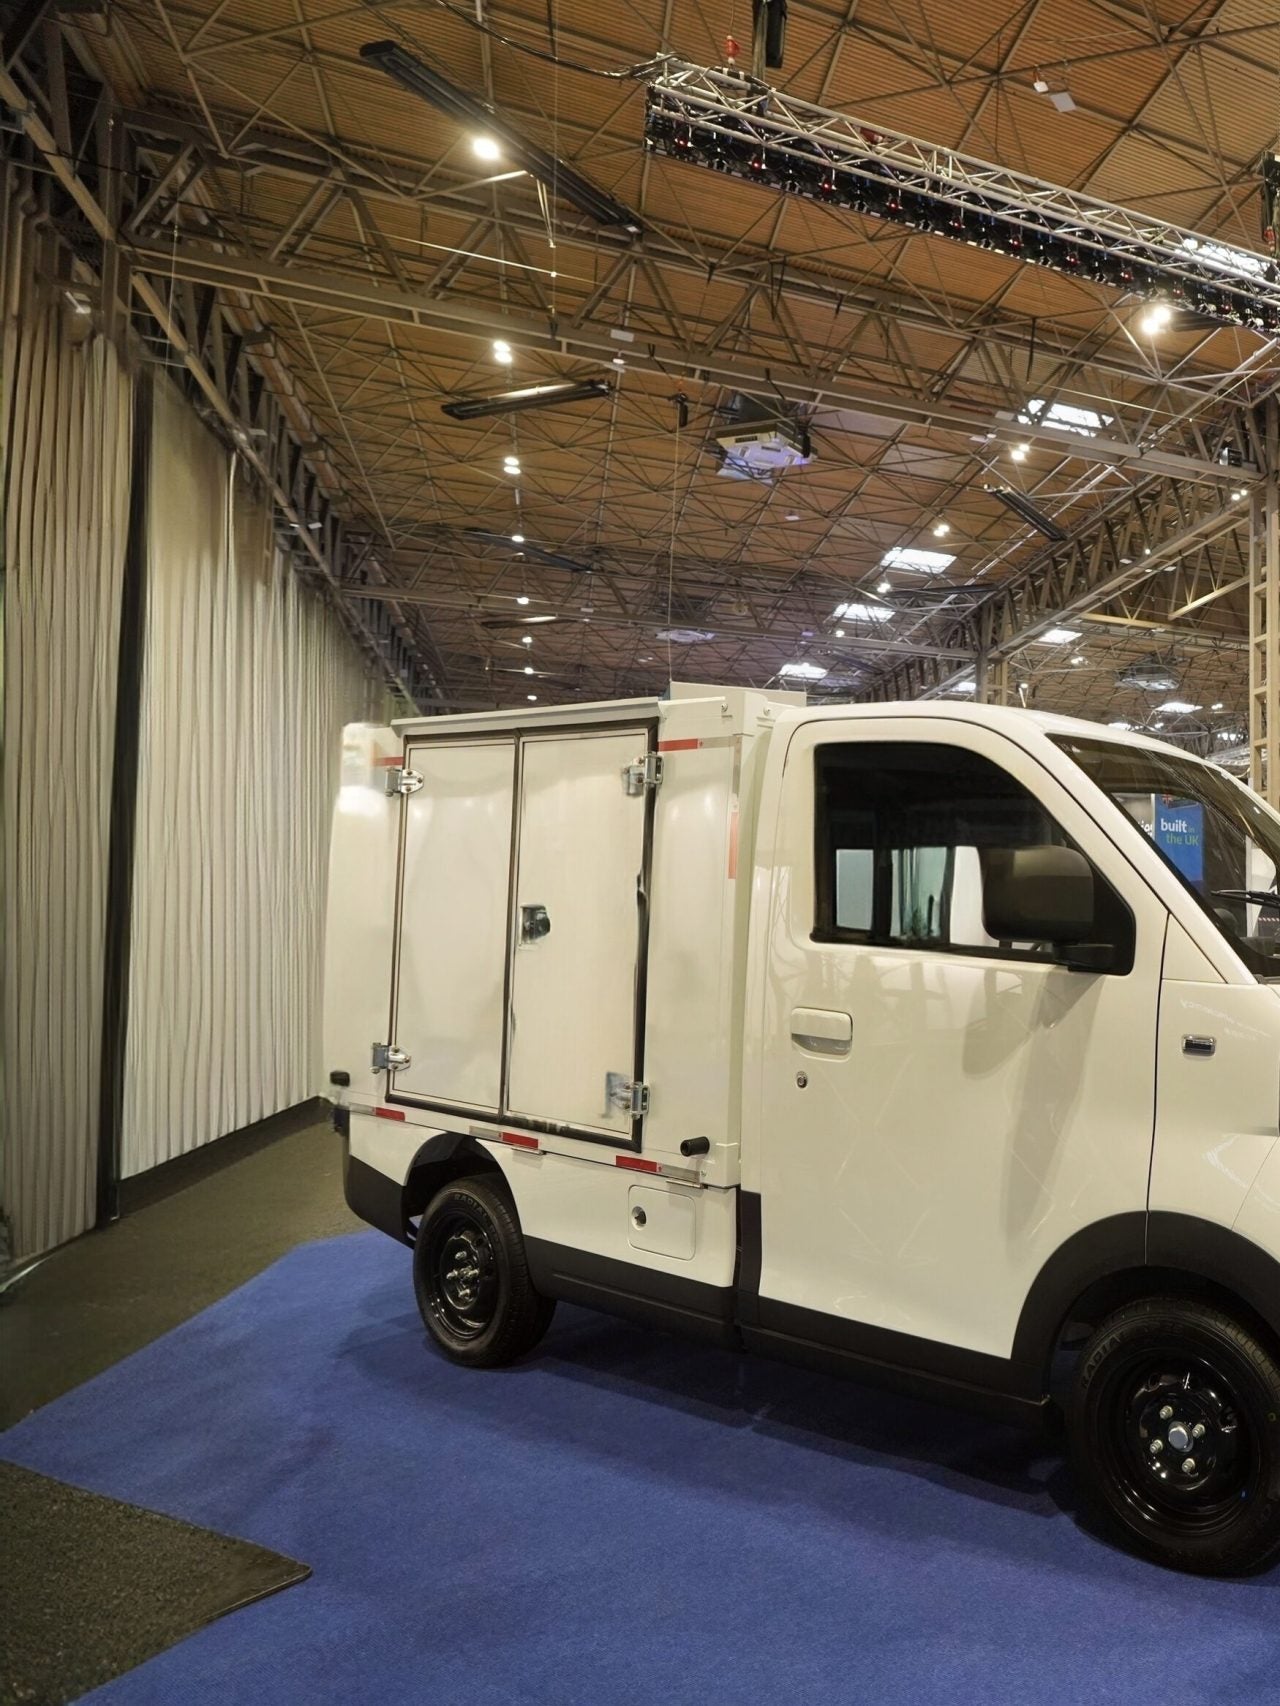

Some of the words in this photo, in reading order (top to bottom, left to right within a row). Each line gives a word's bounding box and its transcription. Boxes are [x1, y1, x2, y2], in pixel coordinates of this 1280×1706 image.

[1161, 818, 1187, 833] built
[1166, 832, 1183, 845] the
[1184, 834, 1199, 847] UK
